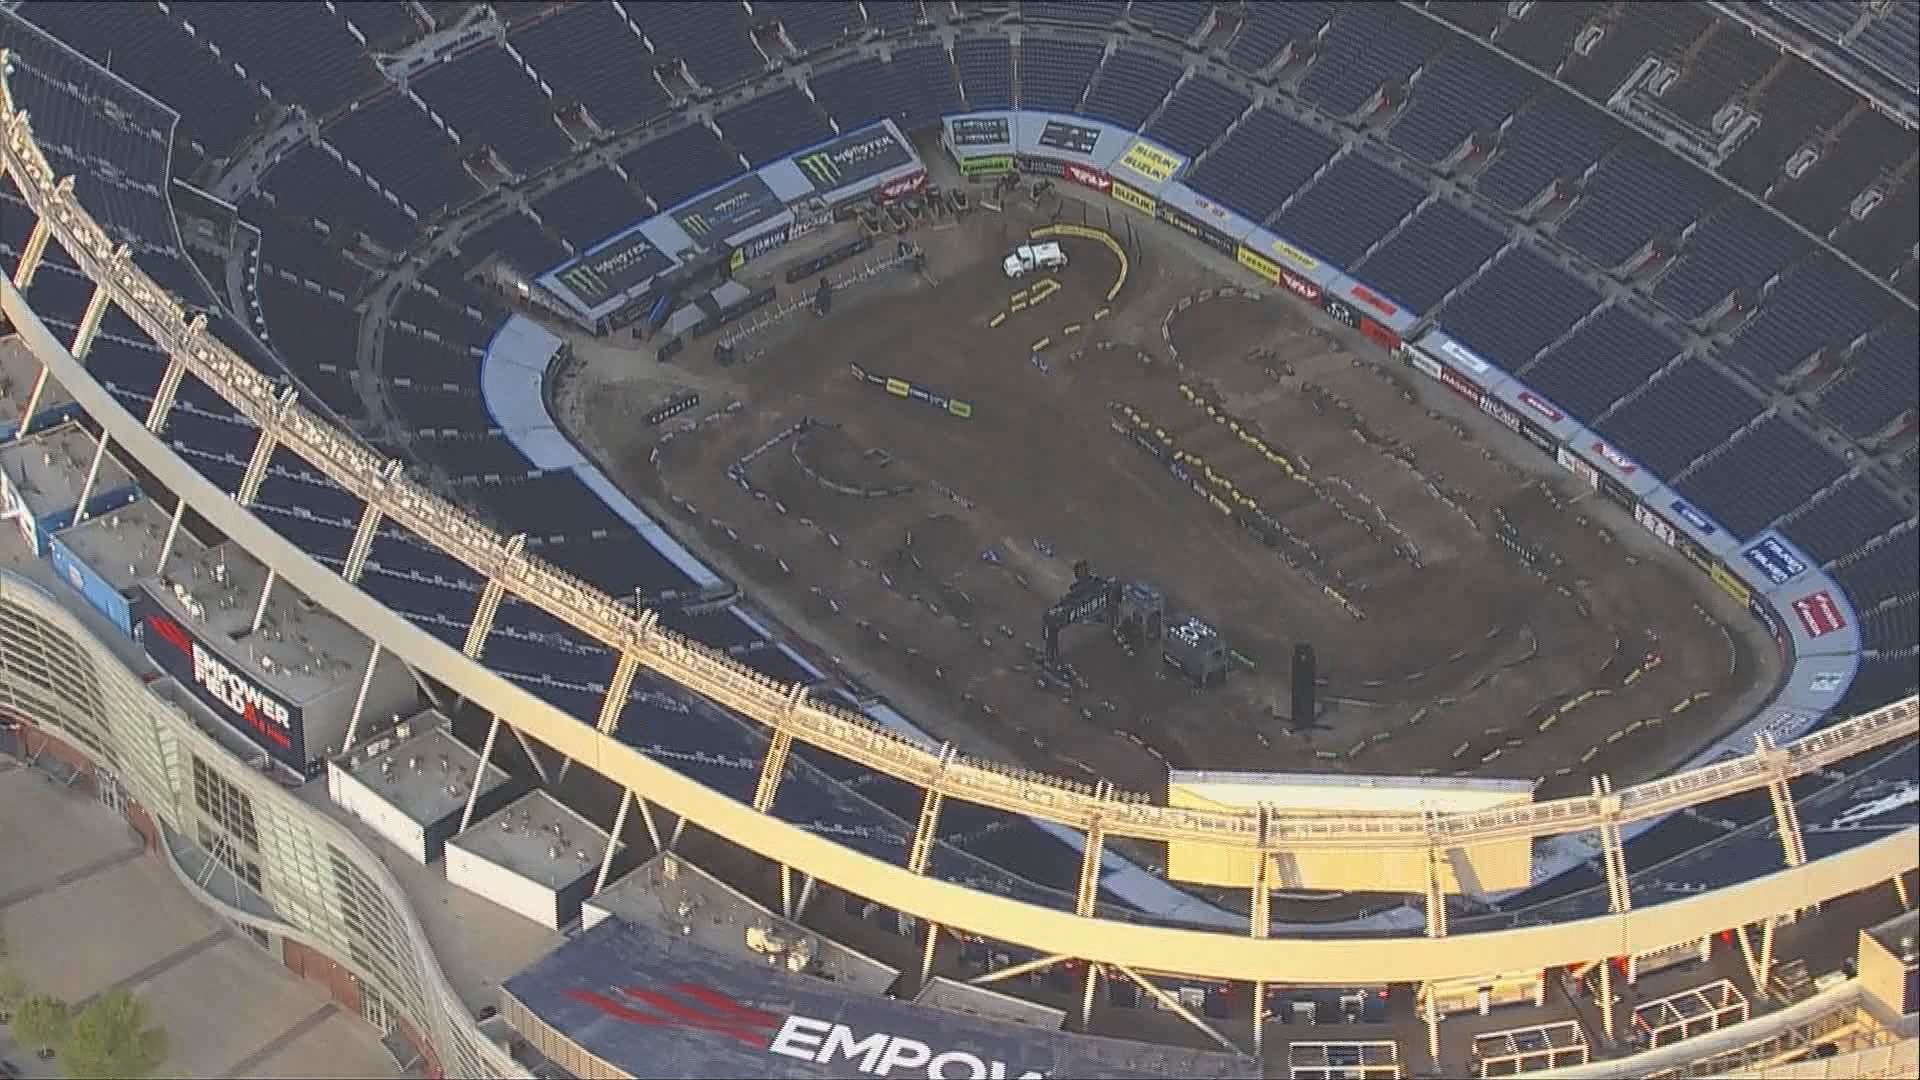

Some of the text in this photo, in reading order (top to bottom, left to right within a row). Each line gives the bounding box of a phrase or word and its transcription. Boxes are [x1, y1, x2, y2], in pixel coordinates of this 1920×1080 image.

[1114, 185, 1153, 211] SUZUKI
[192, 642, 290, 729] EMPOWER
[193, 661, 246, 715] FIELD
